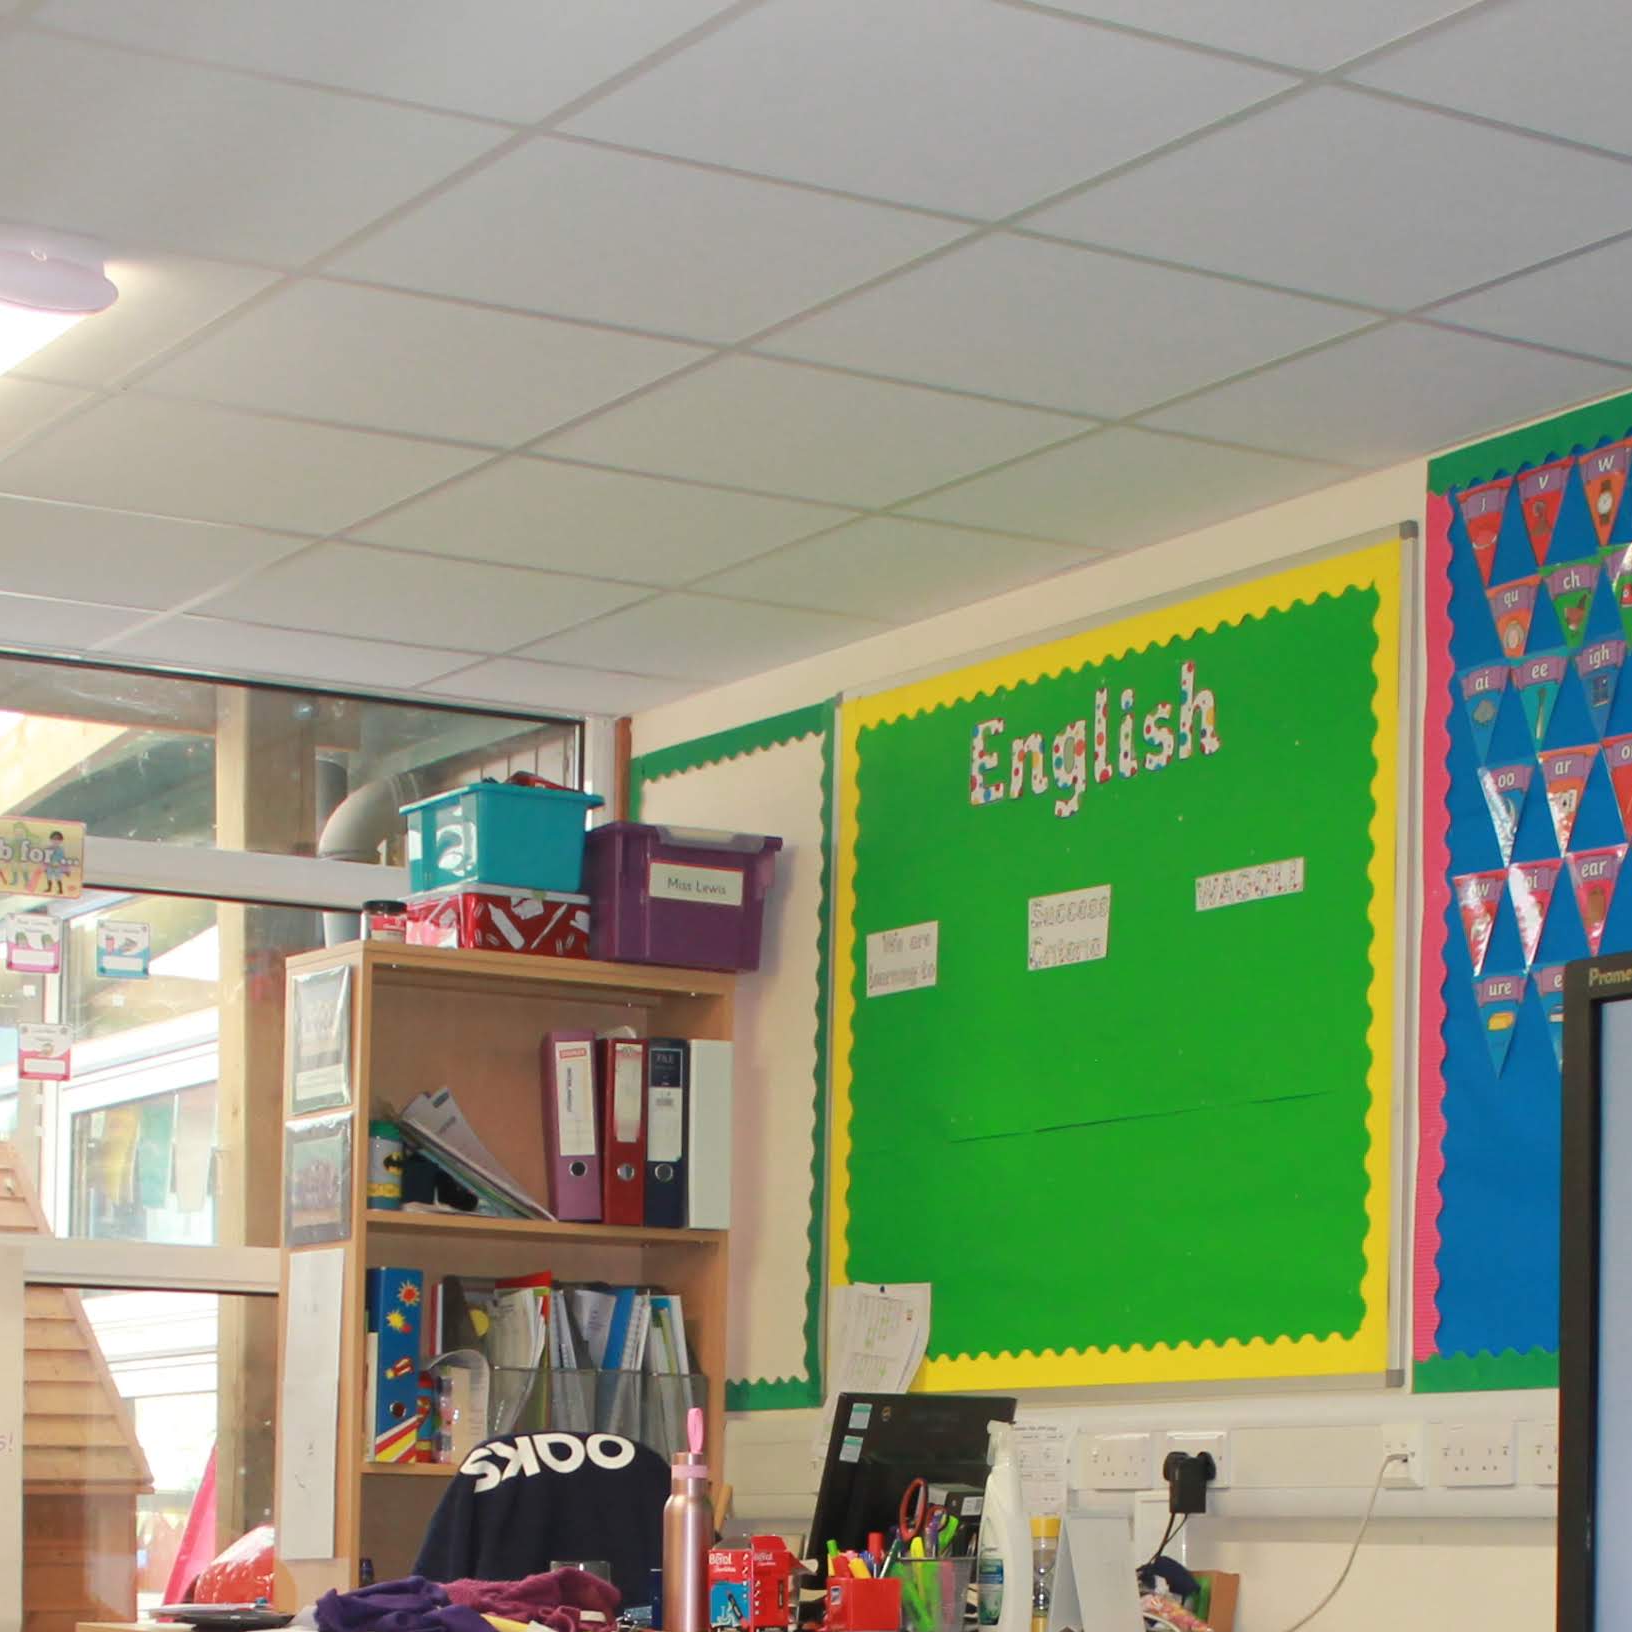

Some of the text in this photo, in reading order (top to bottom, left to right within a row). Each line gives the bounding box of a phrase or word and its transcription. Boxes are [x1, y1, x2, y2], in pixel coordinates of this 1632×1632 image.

[1598, 455, 1616, 473] w
[1563, 571, 1581, 590] ch
[1504, 589, 1519, 608] qu
[1588, 648, 1610, 670] igh
[1532, 662, 1549, 679] ee
[1475, 672, 1489, 689] ai
[970, 659, 1221, 818] English
[1555, 757, 1572, 775] ar
[1498, 773, 1515, 788] oo
[1581, 859, 1608, 877] ear
[667, 877, 726, 895] Miss Lewis
[1488, 980, 1512, 996] ure
